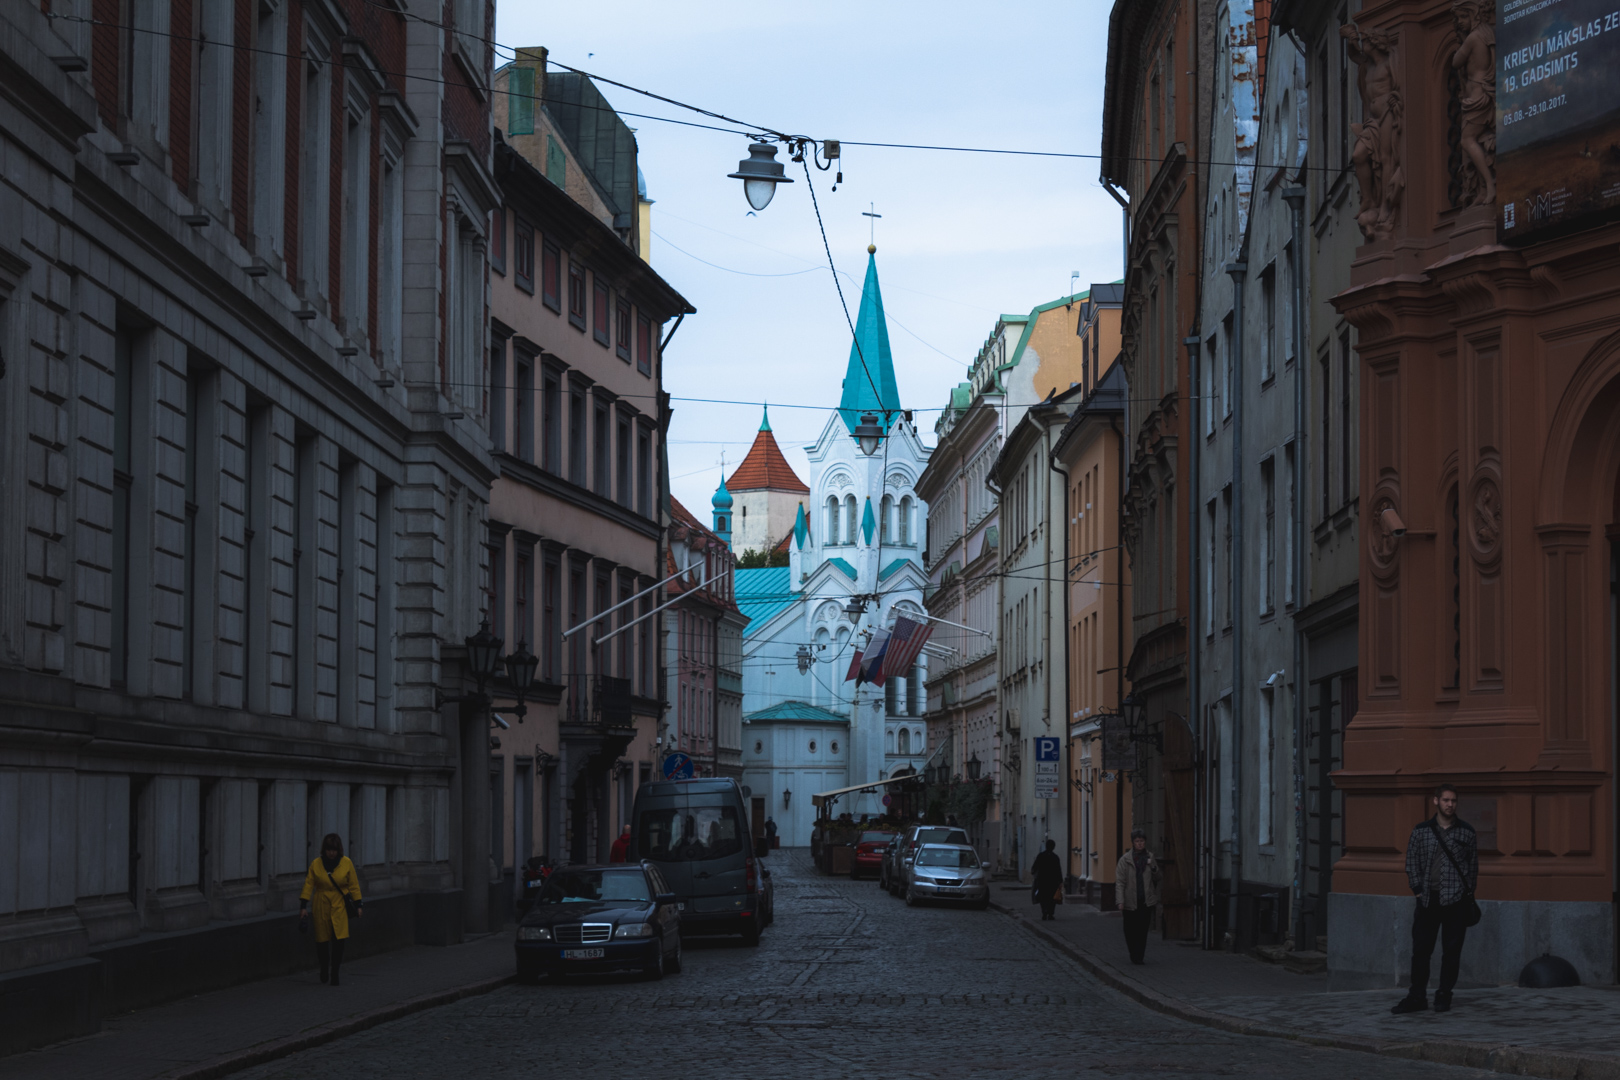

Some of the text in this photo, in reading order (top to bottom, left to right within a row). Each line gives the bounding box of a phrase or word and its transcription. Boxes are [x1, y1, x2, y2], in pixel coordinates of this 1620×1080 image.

[1504, 41, 1544, 71] KRIEVU
[1546, 18, 1601, 54] MĀKSLAS
[1504, 51, 1578, 93] 19. GADSIMTS
[1041, 740, 1055, 759] P
